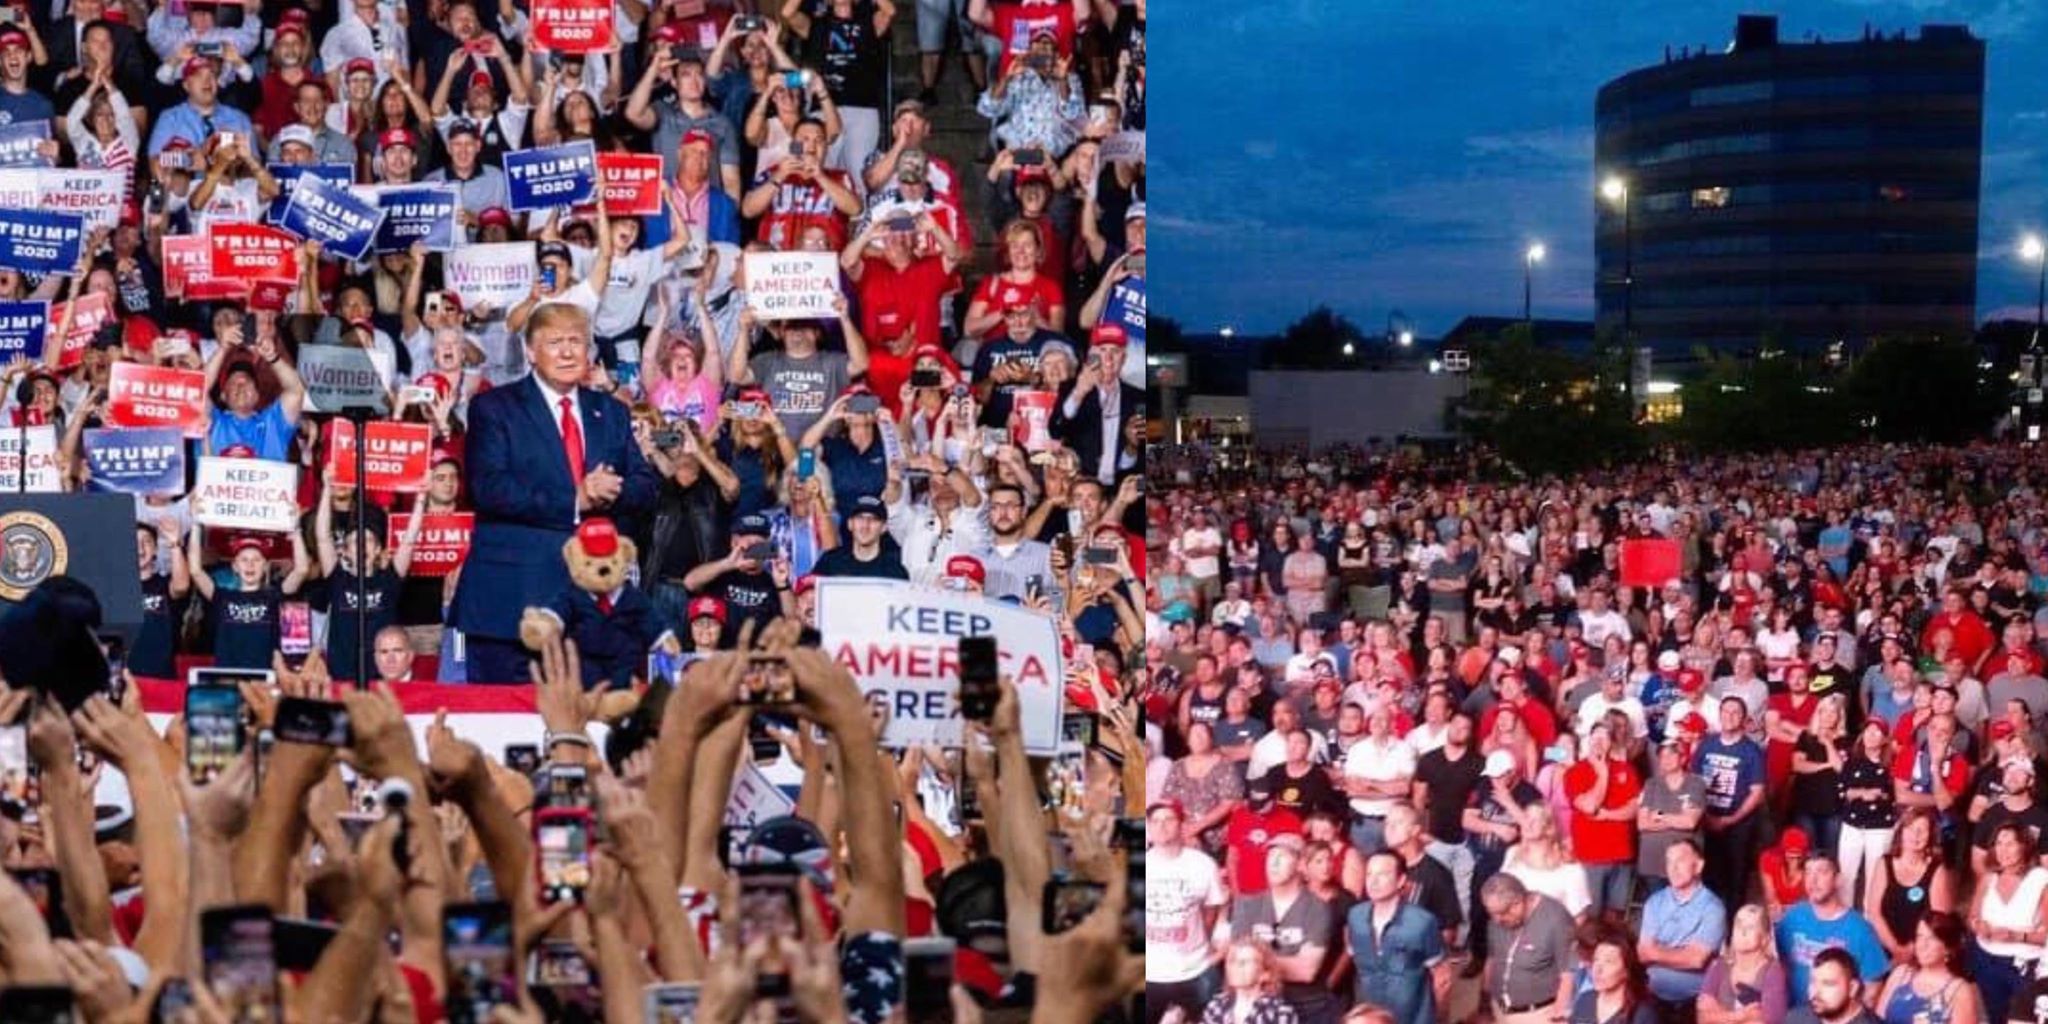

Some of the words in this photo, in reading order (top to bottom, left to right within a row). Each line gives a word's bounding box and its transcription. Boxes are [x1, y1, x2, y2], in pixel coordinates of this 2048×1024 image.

[534, 8, 610, 21] TRUMP
[551, 27, 594, 39] 2020
[510, 156, 591, 180] TRUMP
[606, 167, 657, 181] UMP
[64, 179, 102, 191] KEEP
[531, 180, 575, 196] 2020
[42, 193, 118, 207] AMERICA
[605, 187, 638, 200] 020
[300, 187, 374, 231] TRUMP
[391, 203, 451, 217] RUMP
[0, 221, 79, 241] TRUMP
[305, 215, 348, 242] 2020
[394, 223, 431, 237] 2020
[13, 244, 59, 259] 2020
[233, 255, 278, 267] 2020
[771, 261, 814, 275] KEEP
[451, 262, 530, 283] Women
[752, 275, 835, 294] AMERICA
[764, 296, 823, 310] GREAT!
[302, 361, 381, 386] Women
[116, 379, 200, 400] TRUMP
[133, 403, 180, 419] 2020
[338, 435, 426, 455] TUMP
[0, 453, 54, 470] ERCA
[92, 445, 176, 462] TRUMP
[100, 456, 169, 471] PENCE
[365, 460, 404, 474] 020
[225, 469, 270, 483] KEEP
[203, 484, 289, 502] AMERICA
[214, 502, 277, 519] GREAT!
[887, 604, 992, 637] KEEP
